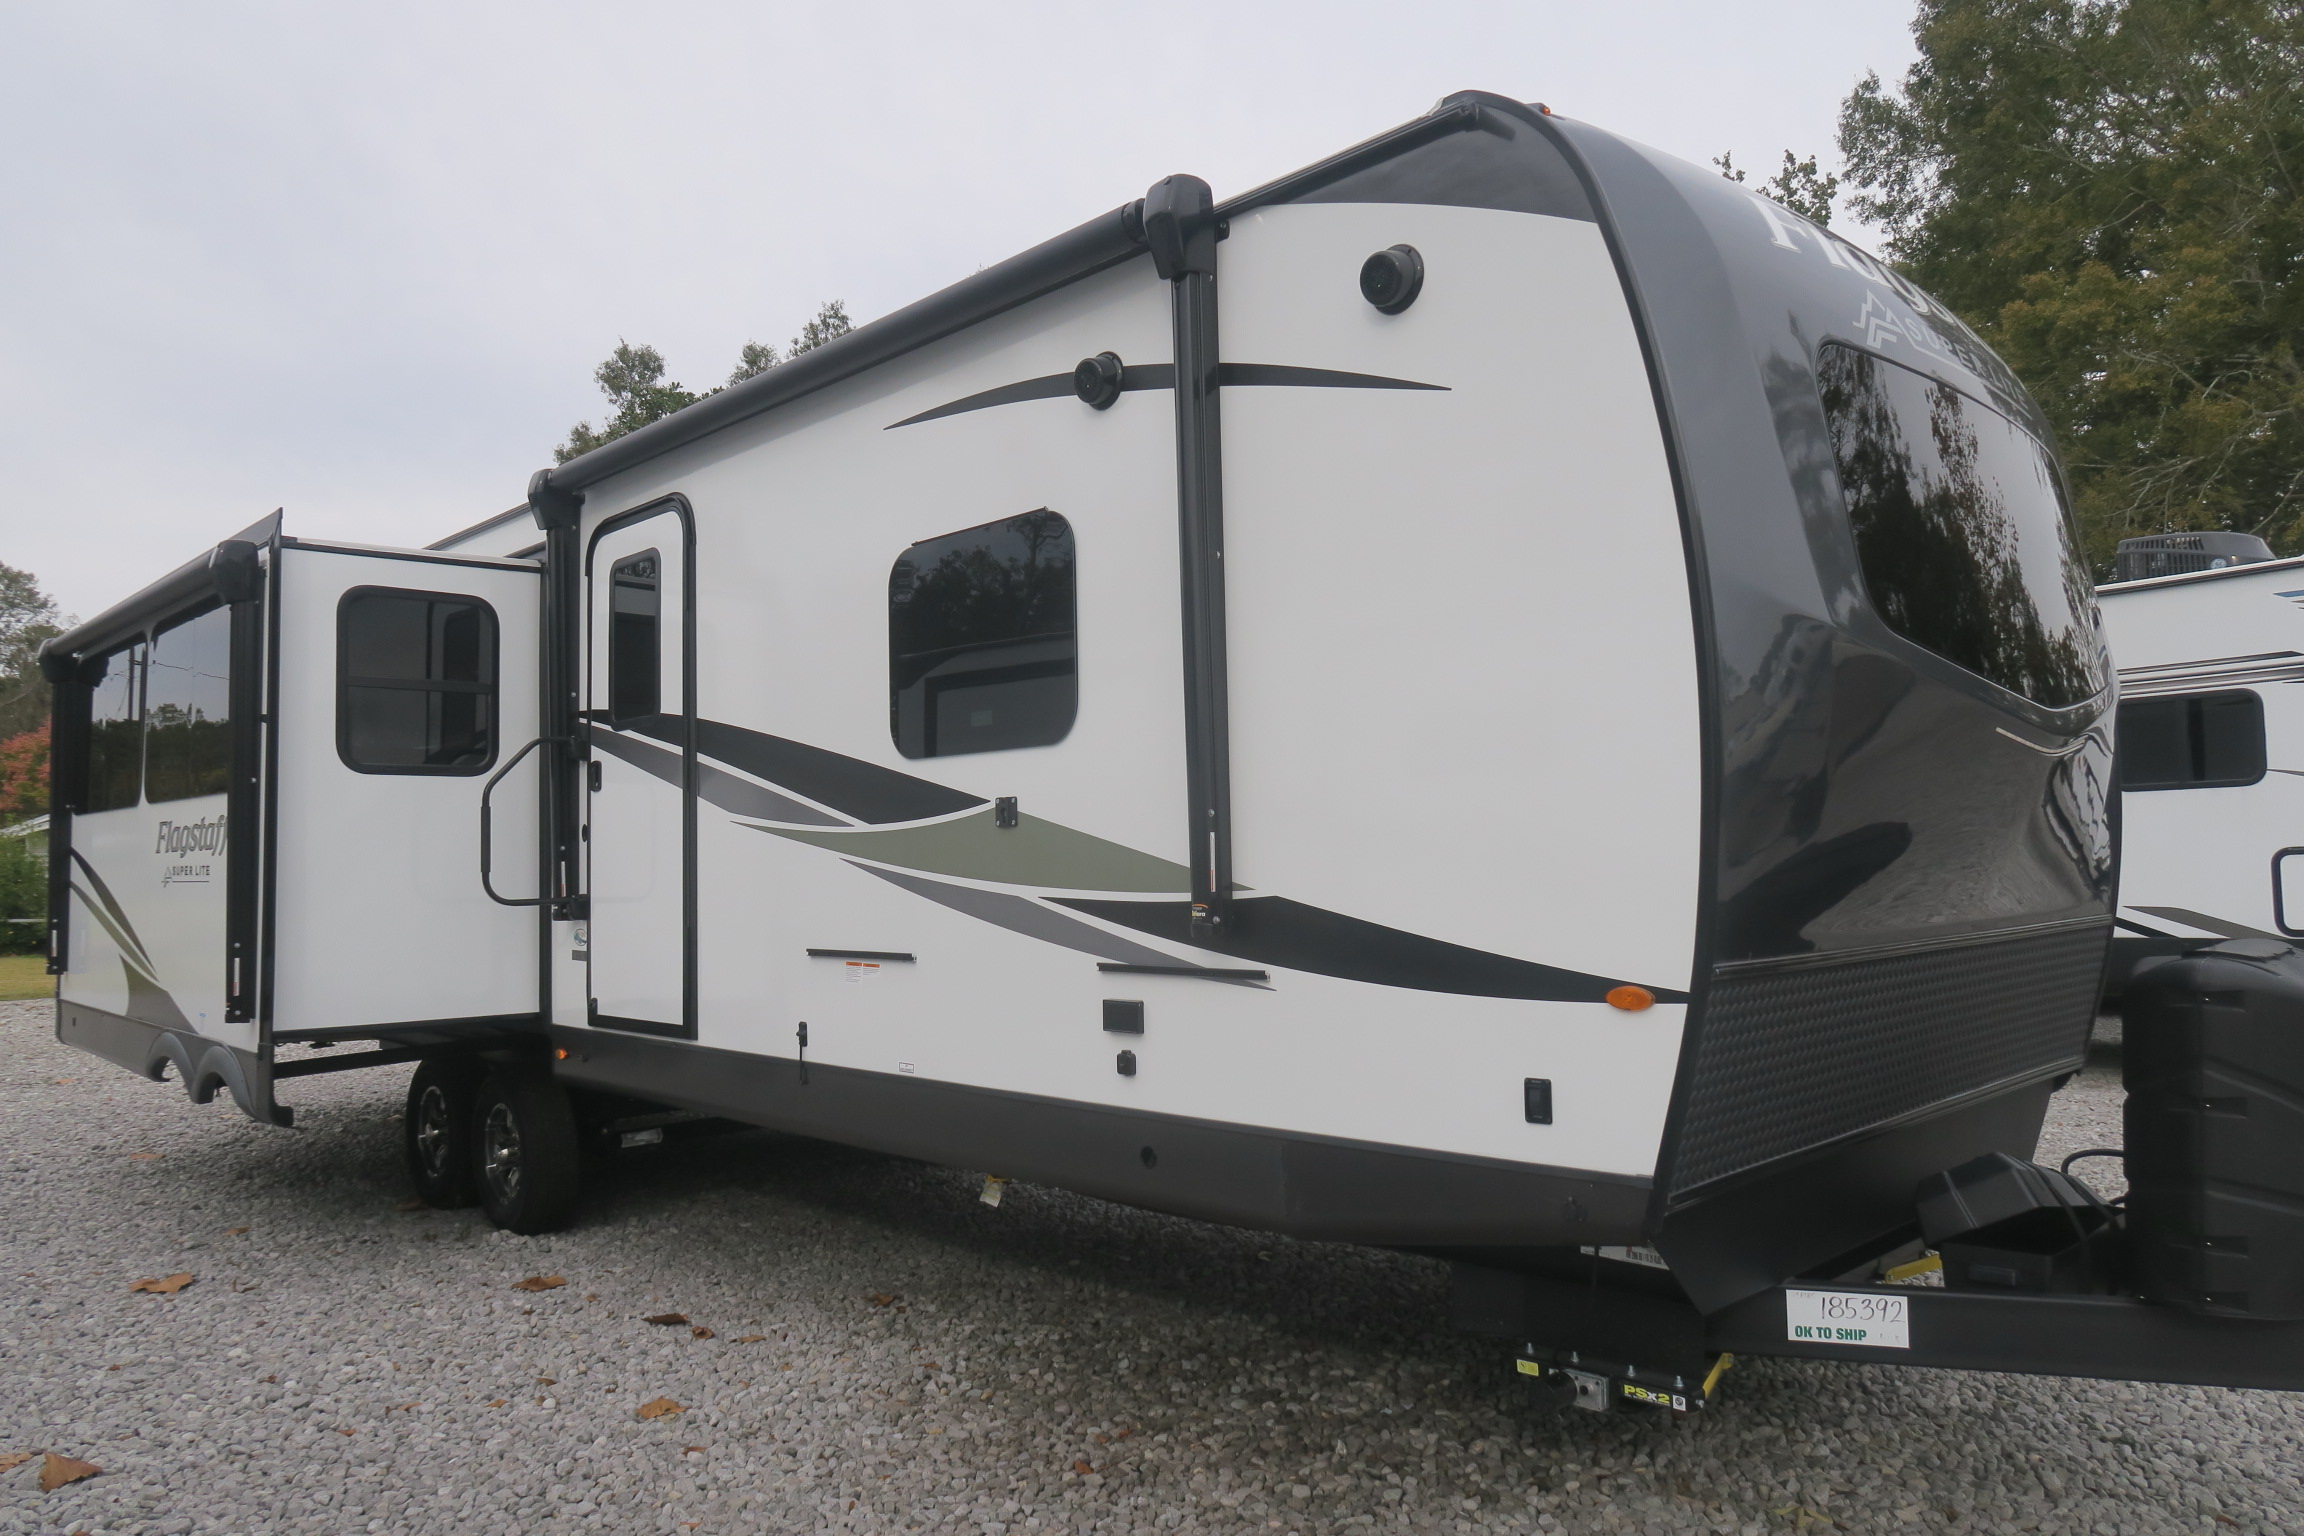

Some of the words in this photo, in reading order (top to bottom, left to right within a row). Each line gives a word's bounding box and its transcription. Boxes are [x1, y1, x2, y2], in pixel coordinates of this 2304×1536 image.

[172, 865, 193, 876] SUPER
[195, 865, 211, 876] LITE
[1821, 1296, 1906, 1323] 185392
[1794, 1325, 1814, 1339] OK
[1816, 1326, 1832, 1339] TO
[1836, 1328, 1867, 1341] SHIP
